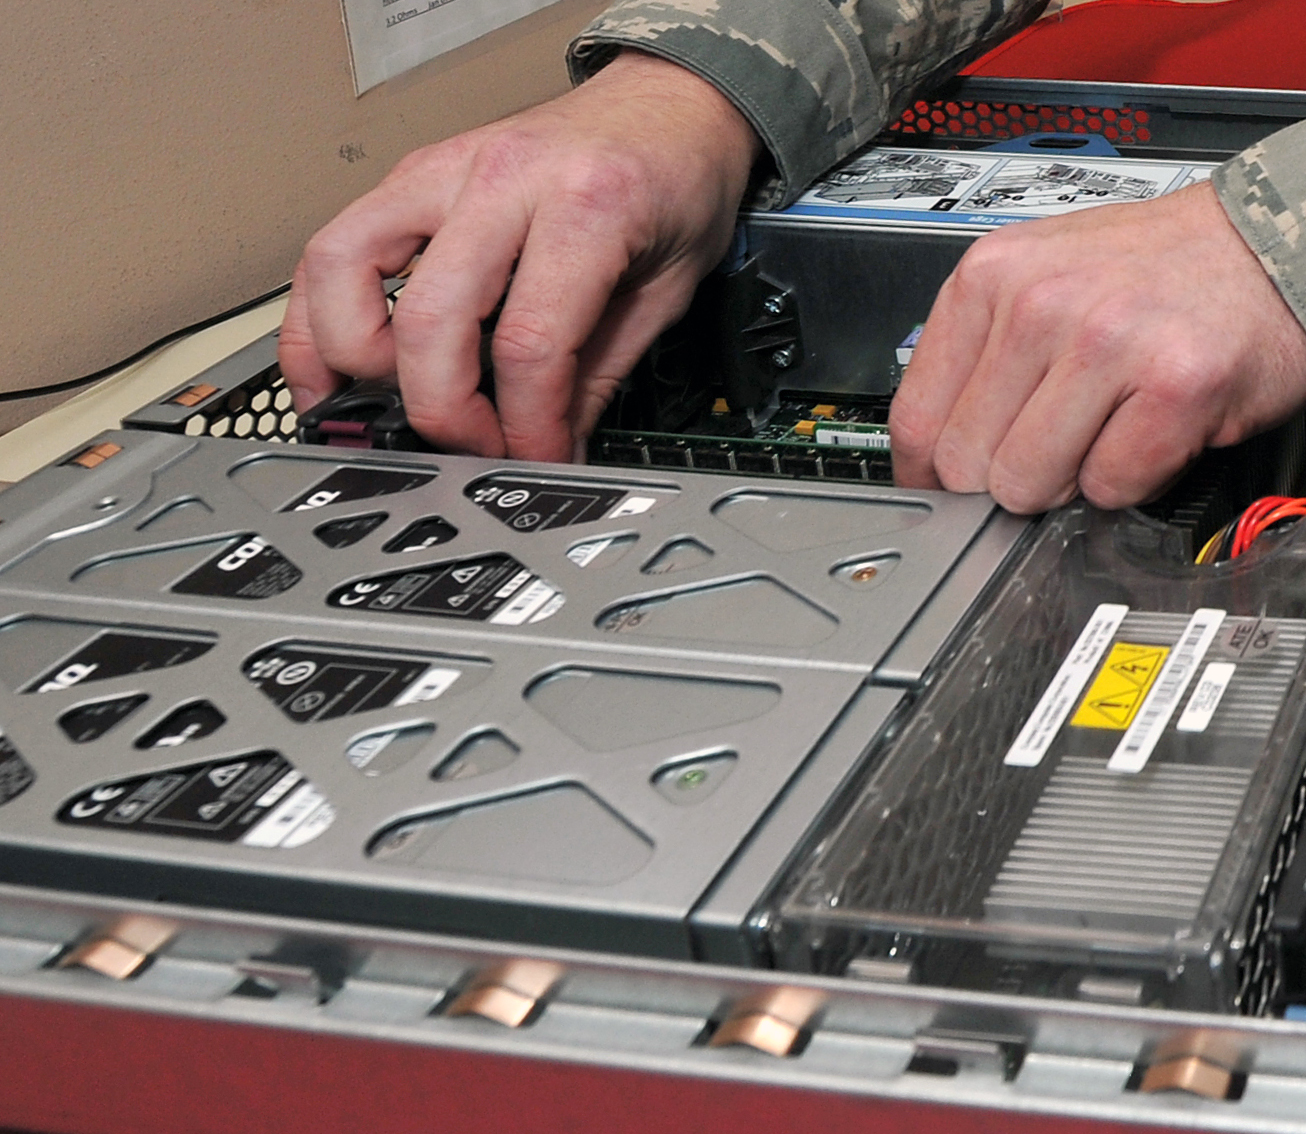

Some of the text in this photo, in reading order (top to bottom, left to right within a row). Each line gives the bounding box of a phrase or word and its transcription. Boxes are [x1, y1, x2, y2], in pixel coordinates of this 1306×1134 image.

[397, 8, 417, 22] Ohms
[428, 0, 440, 11] Jan
[1229, 625, 1253, 649] ATE
[1253, 630, 1274, 649] OK
